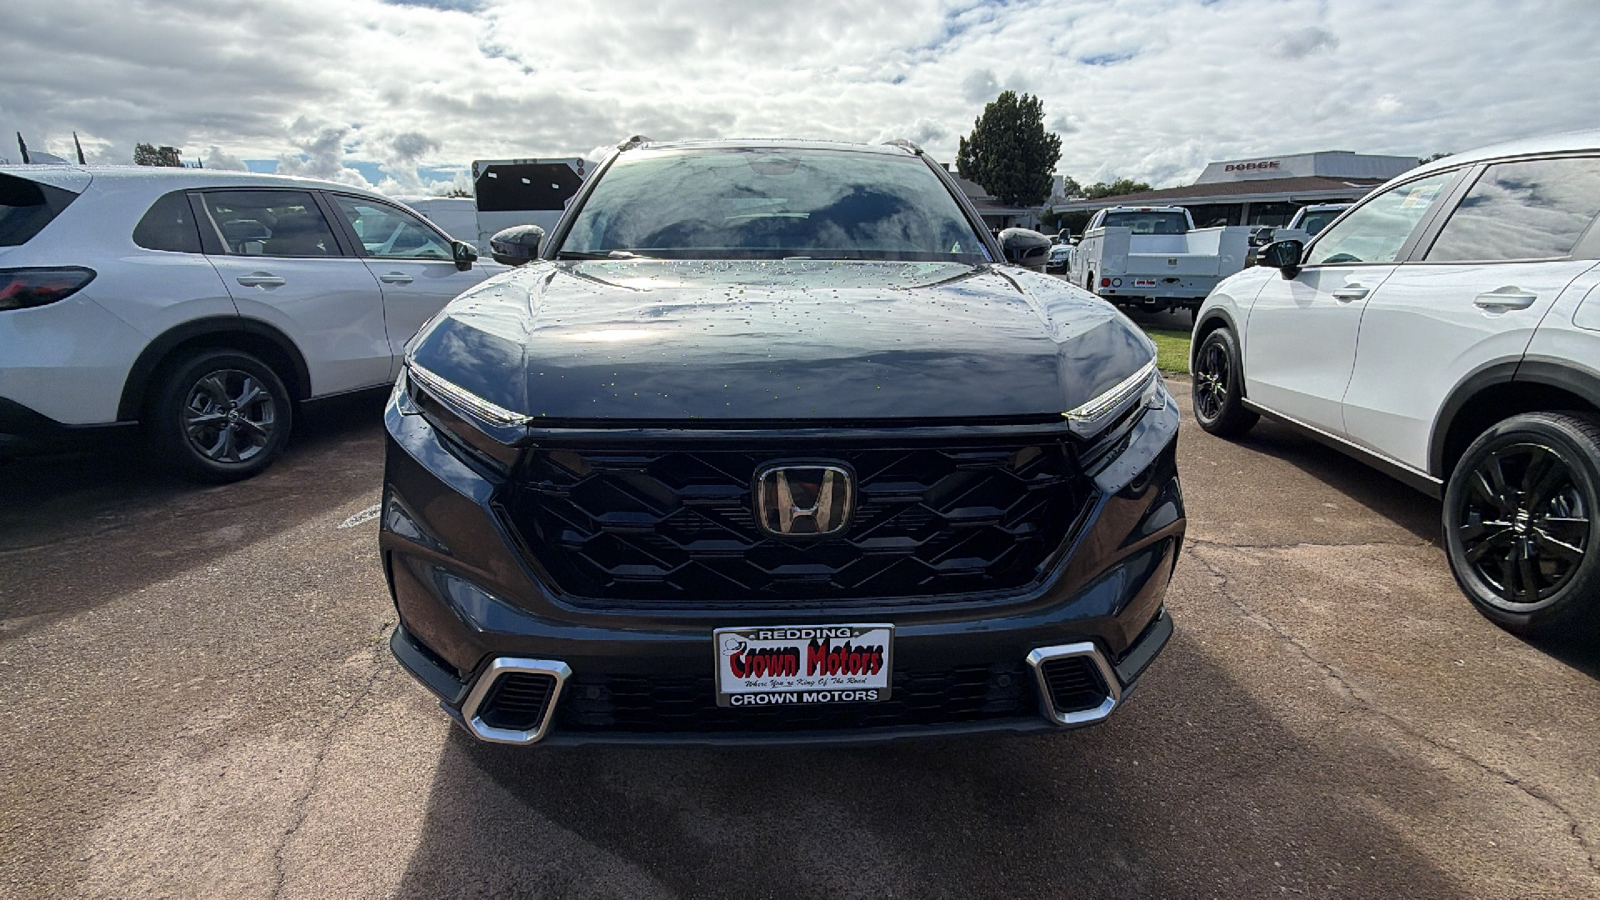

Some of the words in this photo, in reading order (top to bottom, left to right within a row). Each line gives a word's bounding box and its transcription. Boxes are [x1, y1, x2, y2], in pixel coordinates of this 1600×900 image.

[1225, 161, 1280, 172] DODGE
[759, 628, 851, 640] REDDING
[730, 643, 800, 678] Crown
[807, 639, 883, 677] Motors
[744, 679, 768, 688] Where
[796, 678, 815, 687] King
[817, 677, 828, 687] Of
[731, 692, 798, 706] CROWN
[802, 690, 878, 703] MOTORS
